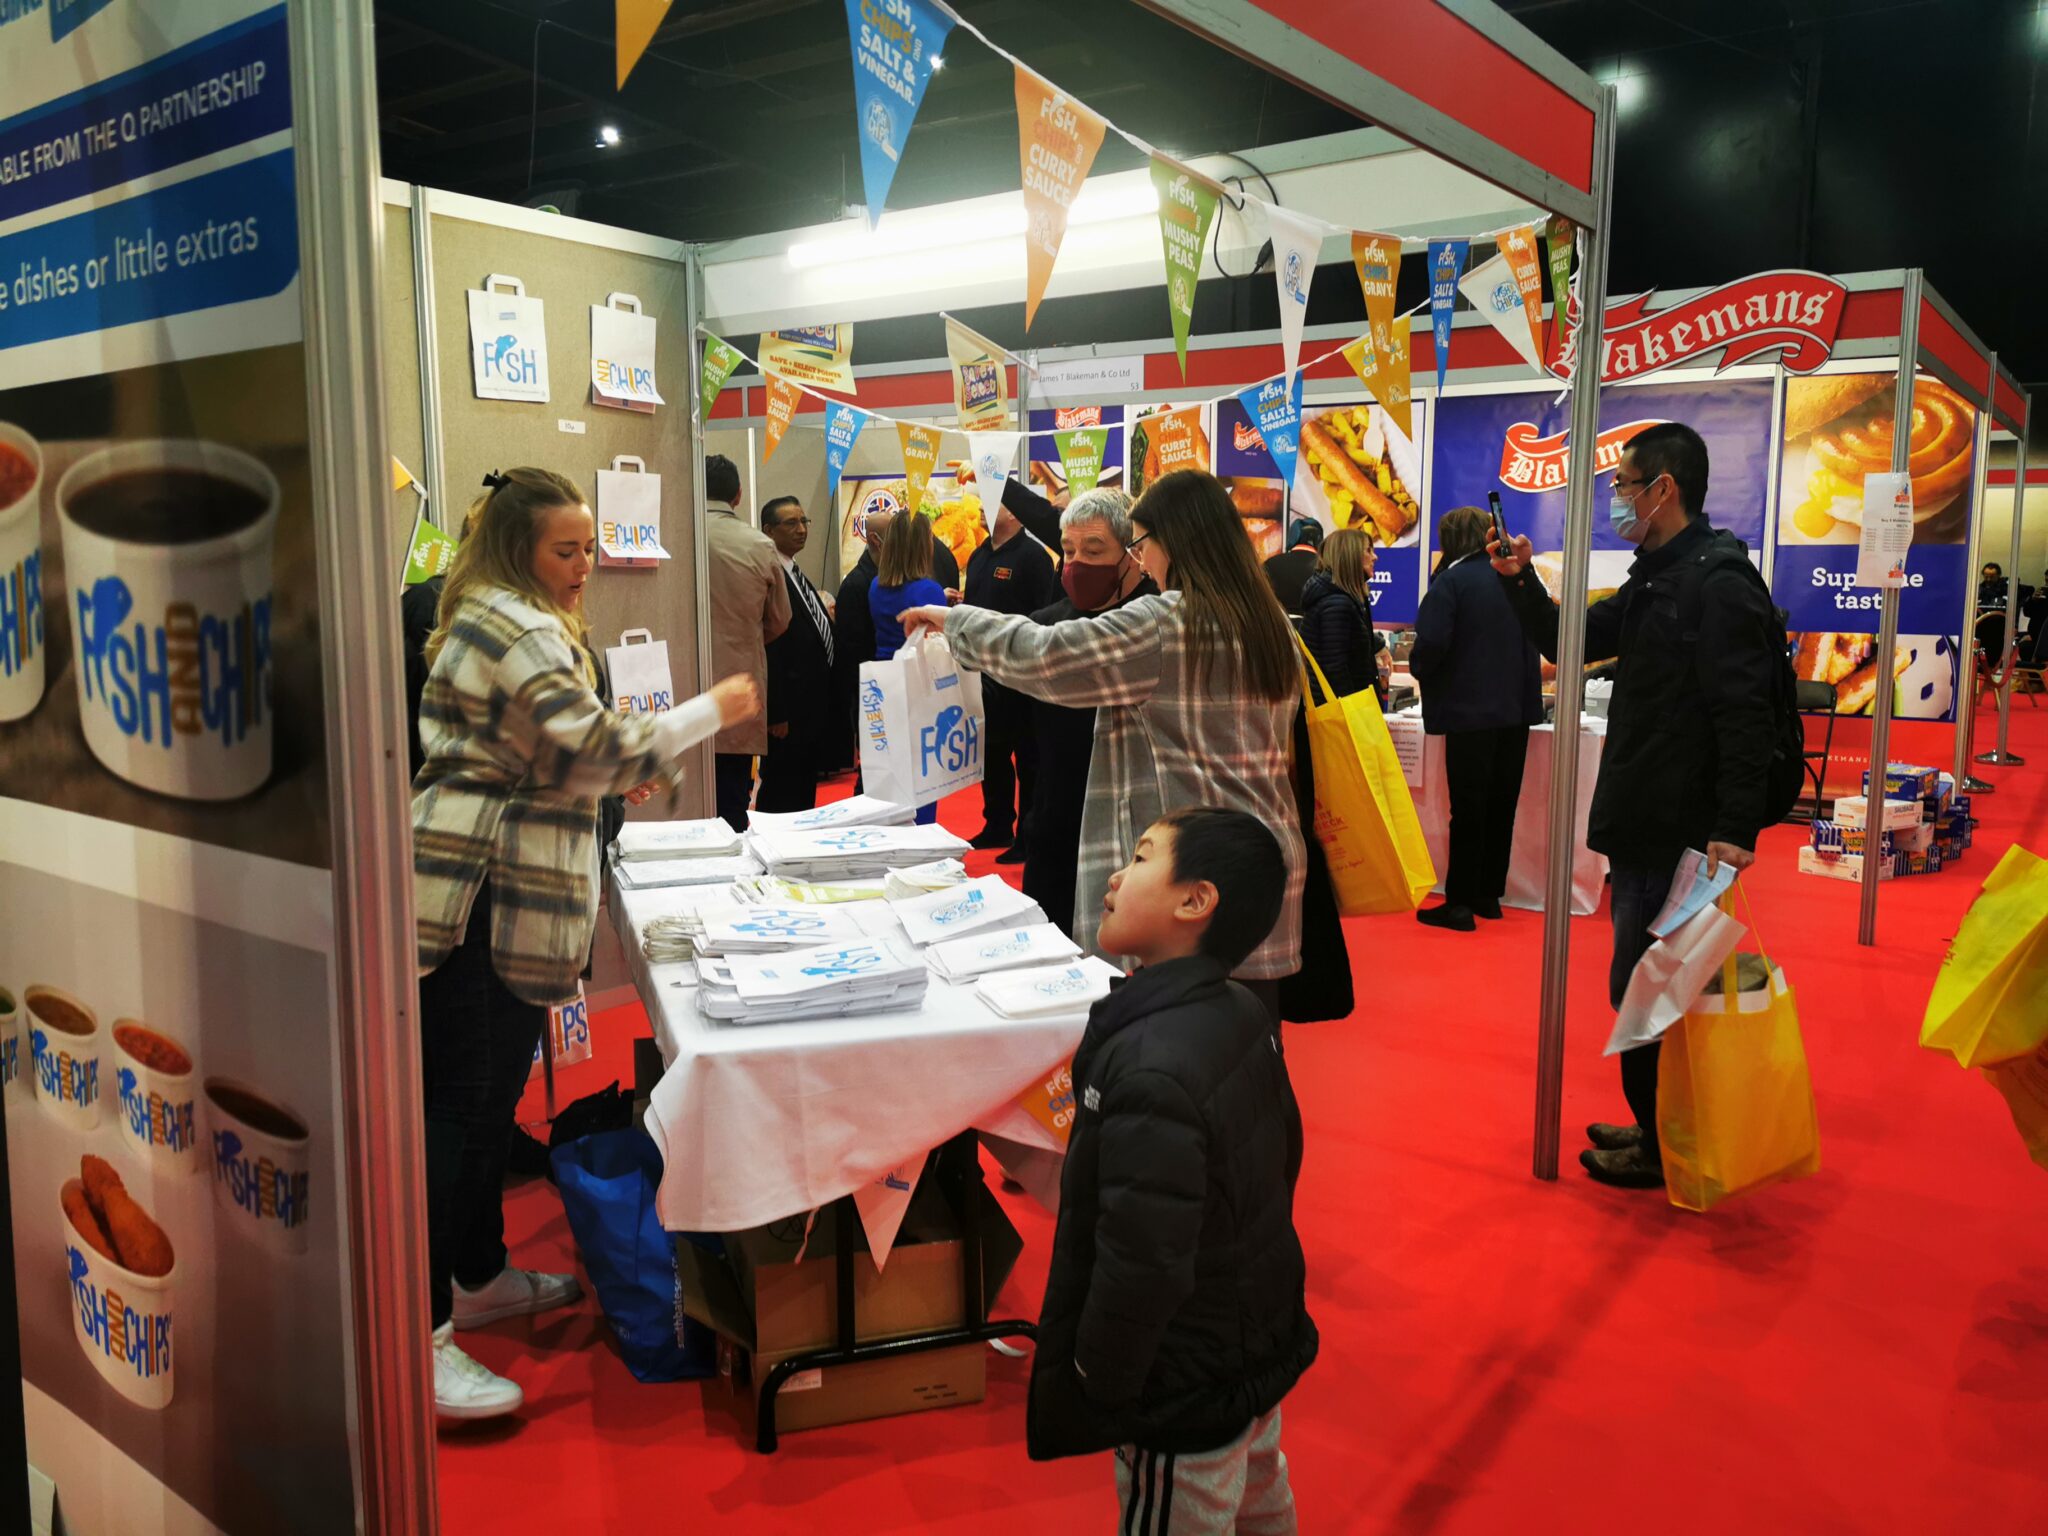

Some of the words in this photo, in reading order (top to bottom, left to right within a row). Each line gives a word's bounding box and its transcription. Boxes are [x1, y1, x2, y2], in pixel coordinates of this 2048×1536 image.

[860, 24, 902, 72] SALT
[903, 60, 915, 87] &
[857, 46, 915, 107] VINEGAR.
[33, 131, 82, 174] FROM
[83, 118, 117, 156] THE
[121, 112, 137, 142] Q
[140, 60, 266, 137] PARTNERSHIP
[1029, 143, 1077, 185] CURRY
[1164, 220, 1200, 253] MUSHY
[14, 257, 78, 306] dishes
[85, 255, 109, 288] or
[115, 228, 168, 282] little
[176, 217, 259, 265] extras
[1169, 242, 1195, 272] PEAS.
[1364, 281, 1394, 298] GRAVY.
[1434, 283, 1448, 298] SALT
[609, 362, 654, 395] CHIPS
[1039, 375, 1059, 383] James
[1067, 371, 1099, 381] Blakeman
[1108, 370, 1118, 378] Co
[1120, 368, 1131, 377] Ltd
[1131, 382, 1139, 391] 53
[1260, 407, 1286, 425] SALT
[1287, 404, 1296, 415] &
[1261, 415, 1299, 433] VINEGAR.
[829, 427, 846, 440] SALT
[905, 447, 934, 462] GRAVY.
[1160, 438, 1192, 454] CURRY
[1066, 455, 1099, 470] MUSHY
[1161, 450, 1196, 465] SAUCE.
[1070, 466, 1095, 478] PEAS.
[614, 523, 658, 554] CHIPS
[1834, 591, 1884, 610] tast
[921, 704, 977, 777] FISH
[123, 1304, 173, 1379] CHIPS
